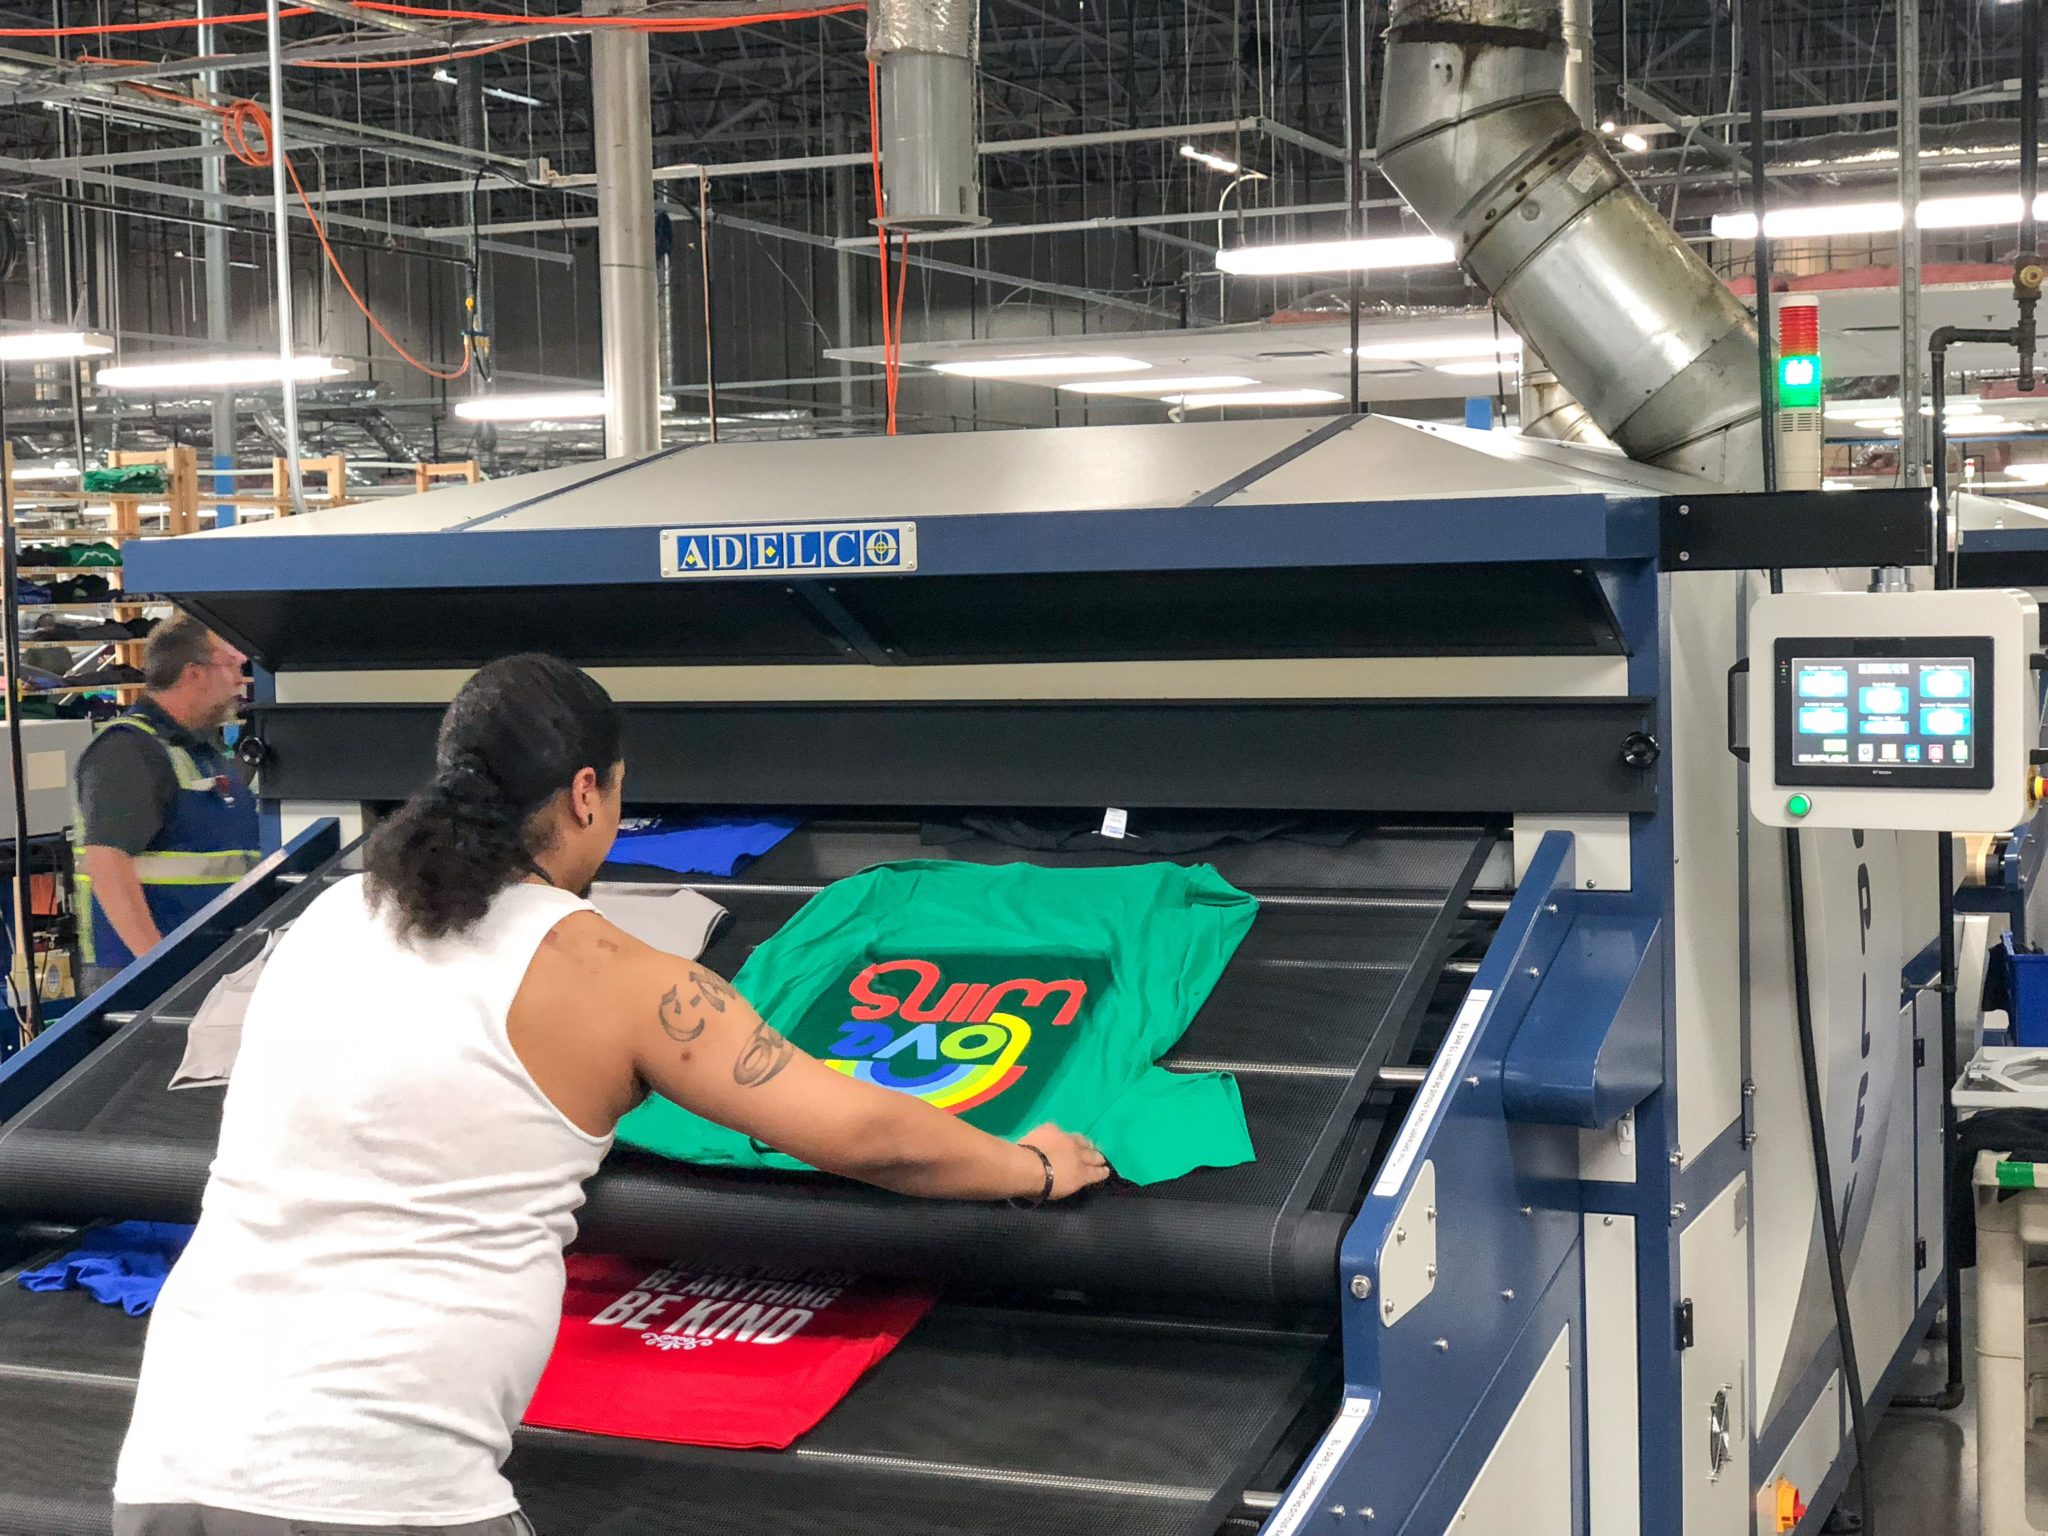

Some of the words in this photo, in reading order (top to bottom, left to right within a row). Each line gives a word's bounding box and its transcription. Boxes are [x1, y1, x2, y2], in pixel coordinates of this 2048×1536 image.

[680, 530, 899, 569] ADELCO
[636, 1268, 692, 1292] BE
[679, 1274, 844, 1310] ANYTHING
[588, 1290, 684, 1331] BE
[664, 1298, 814, 1345] KIND
